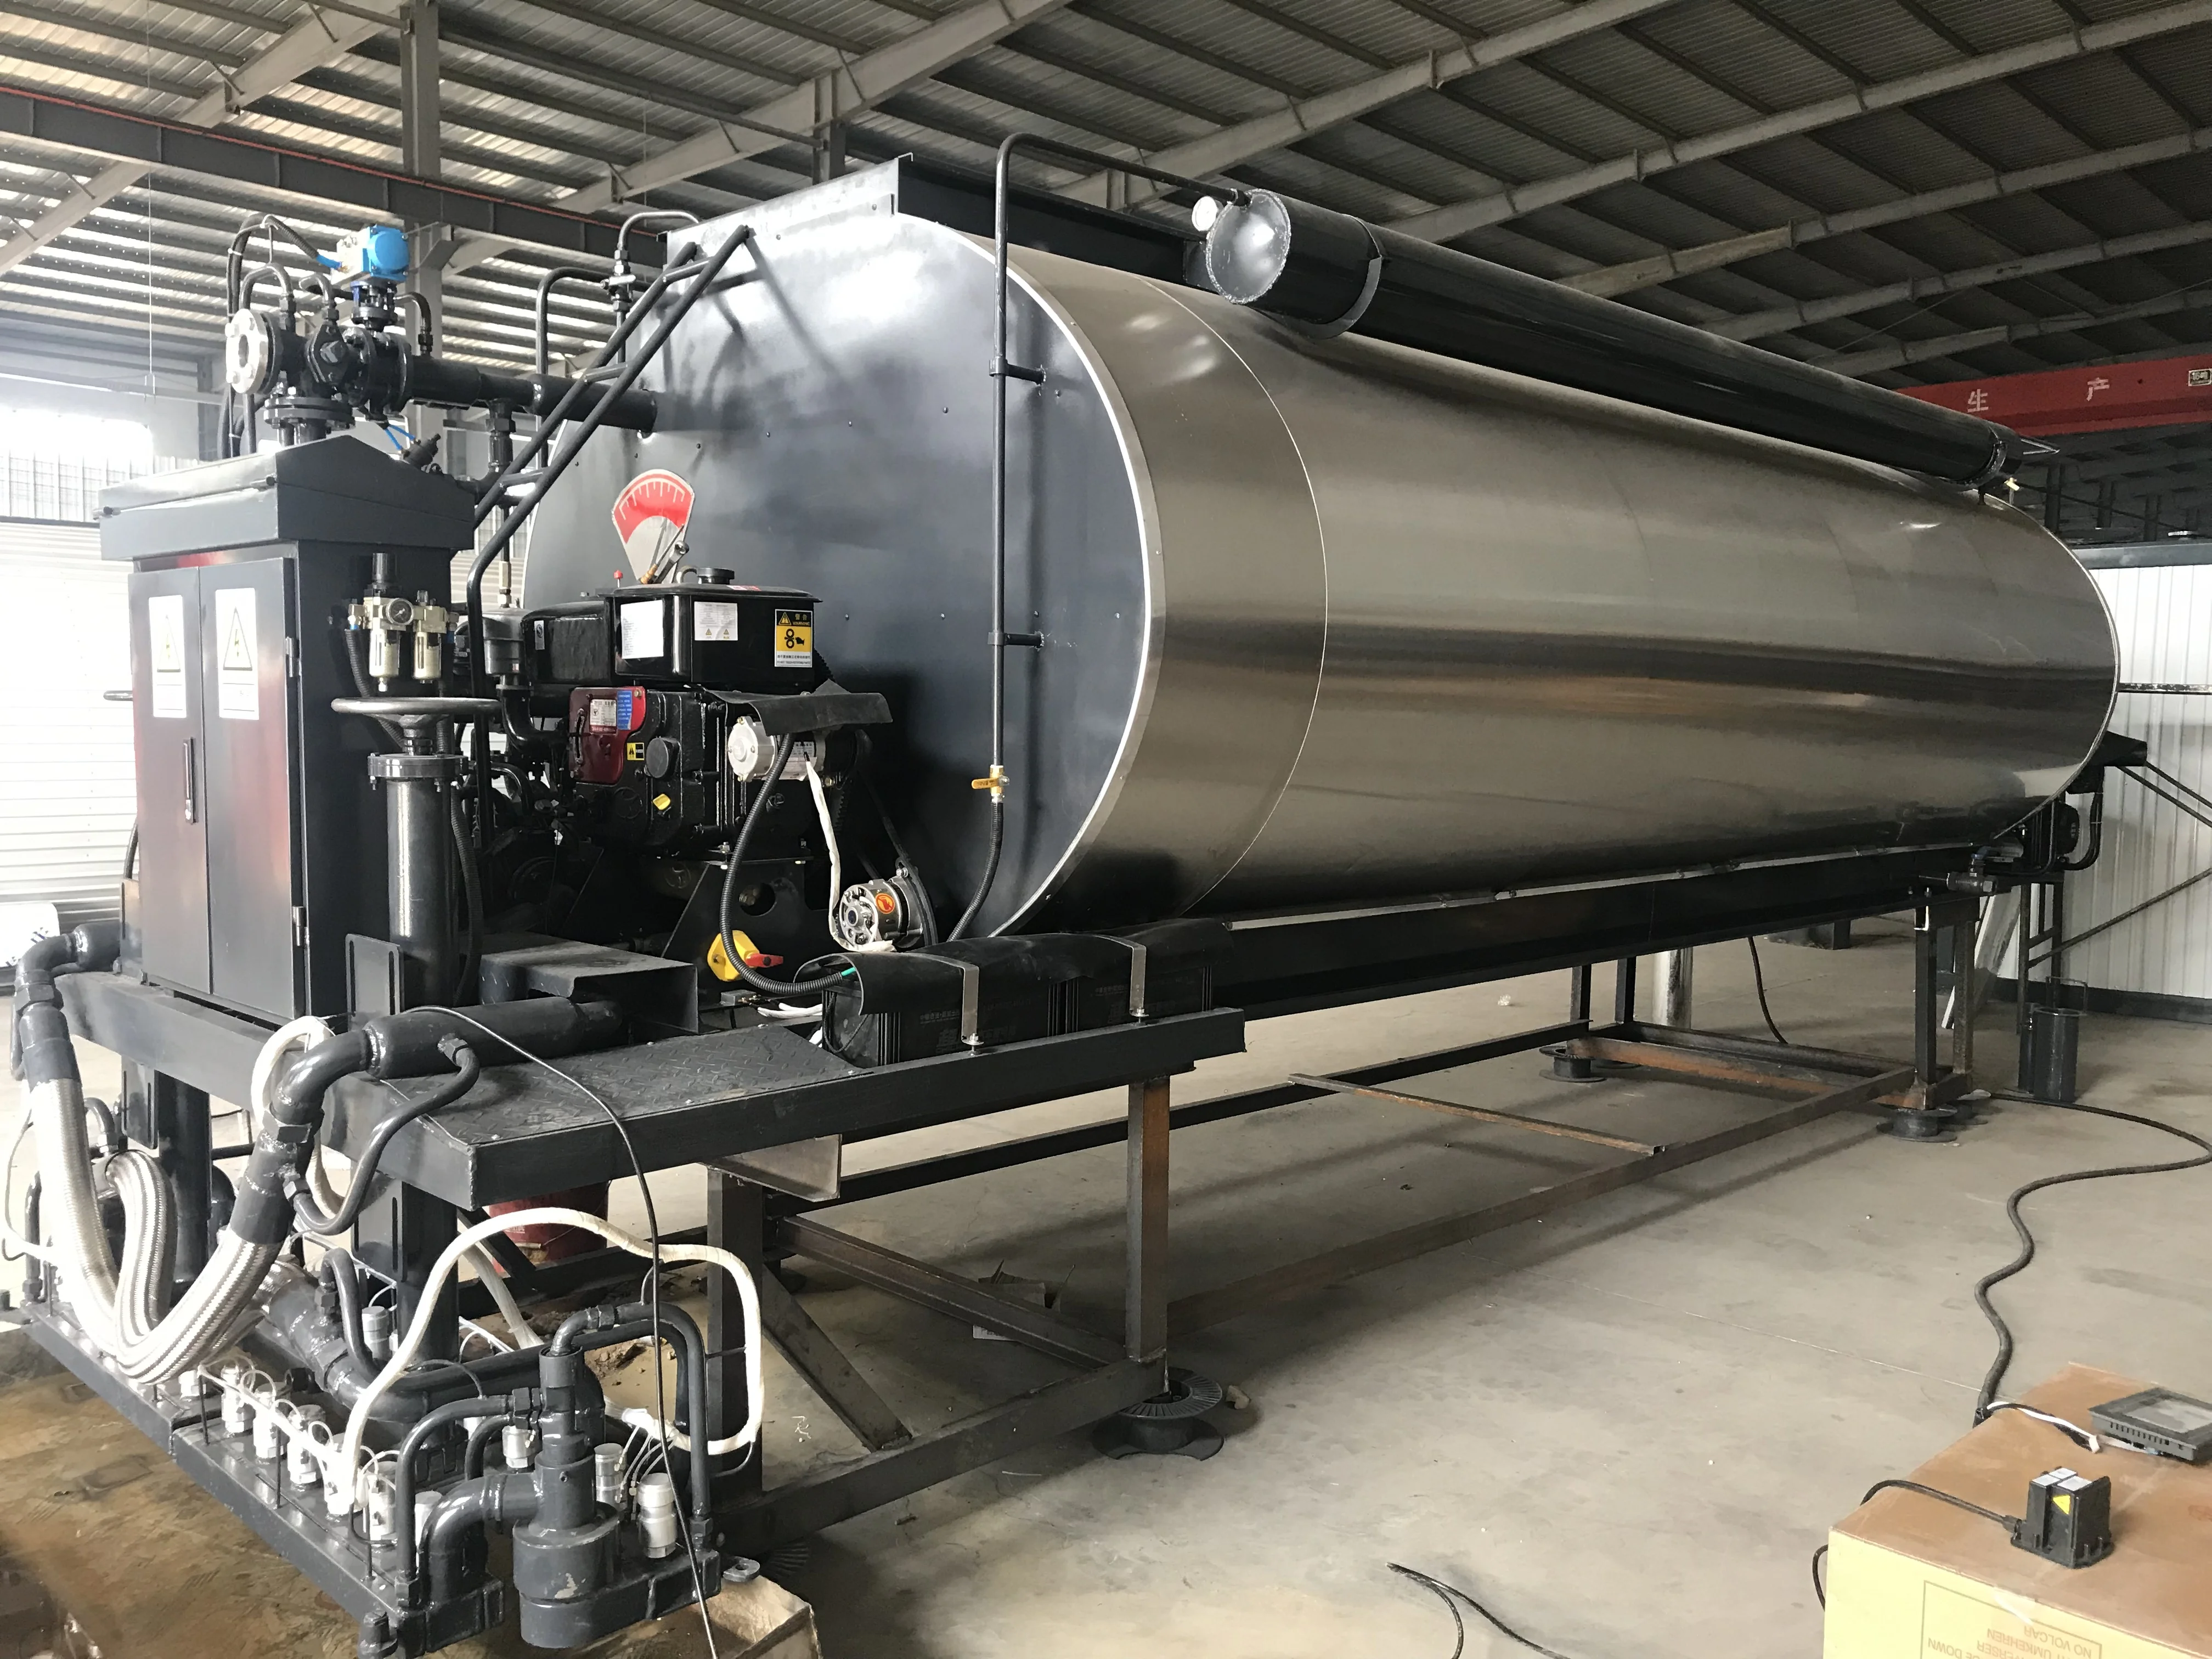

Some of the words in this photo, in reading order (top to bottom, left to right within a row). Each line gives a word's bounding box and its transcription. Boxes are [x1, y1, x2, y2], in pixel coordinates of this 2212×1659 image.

[1967, 388, 1989, 413] 生
[2086, 377, 2110, 402] 产
[1928, 1637, 1962, 1659] DOWN
[1987, 1628, 2052, 1659] UMKEHREN
[2024, 1626, 2071, 1652] VOLCAR
[2074, 1644, 2092, 1659] NO
